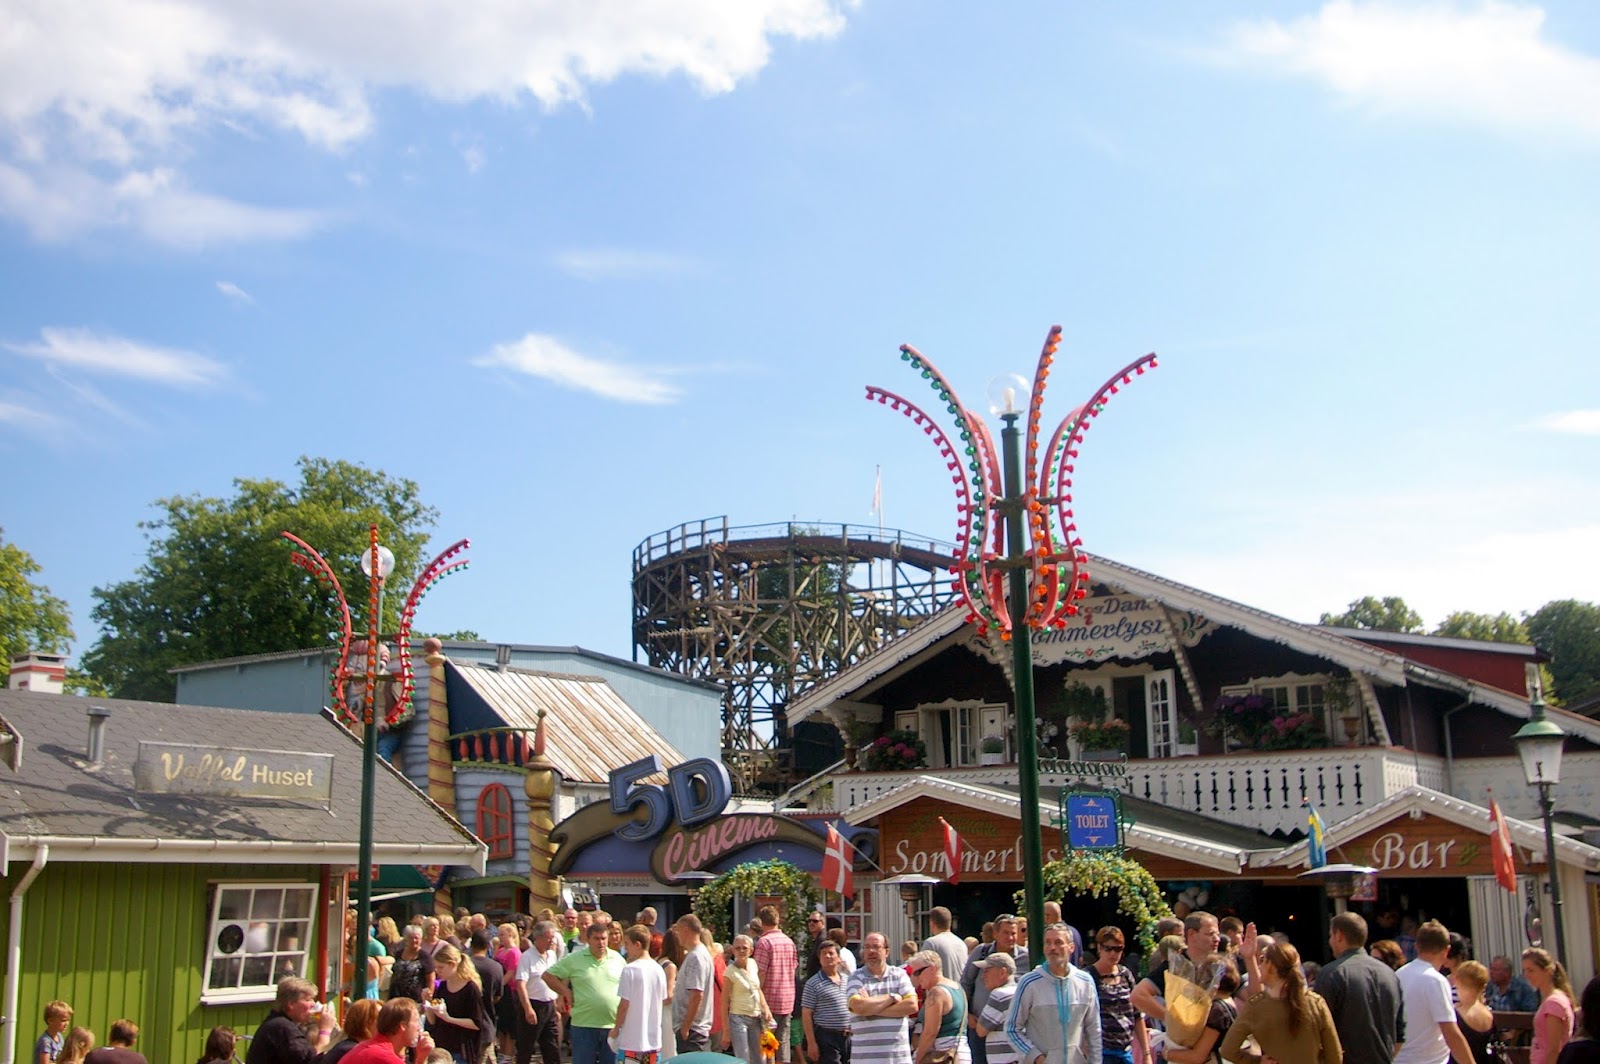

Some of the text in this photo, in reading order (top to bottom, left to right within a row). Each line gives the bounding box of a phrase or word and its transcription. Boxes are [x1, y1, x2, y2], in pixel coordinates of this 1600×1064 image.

[1103, 598, 1153, 615] Dan
[1031, 616, 1165, 645] ommerlyst
[252, 764, 314, 787] Huset
[608, 754, 732, 842] 5D
[1075, 814, 1109, 828] TOILET
[663, 816, 779, 881] Cinema
[1371, 832, 1456, 871] Bar
